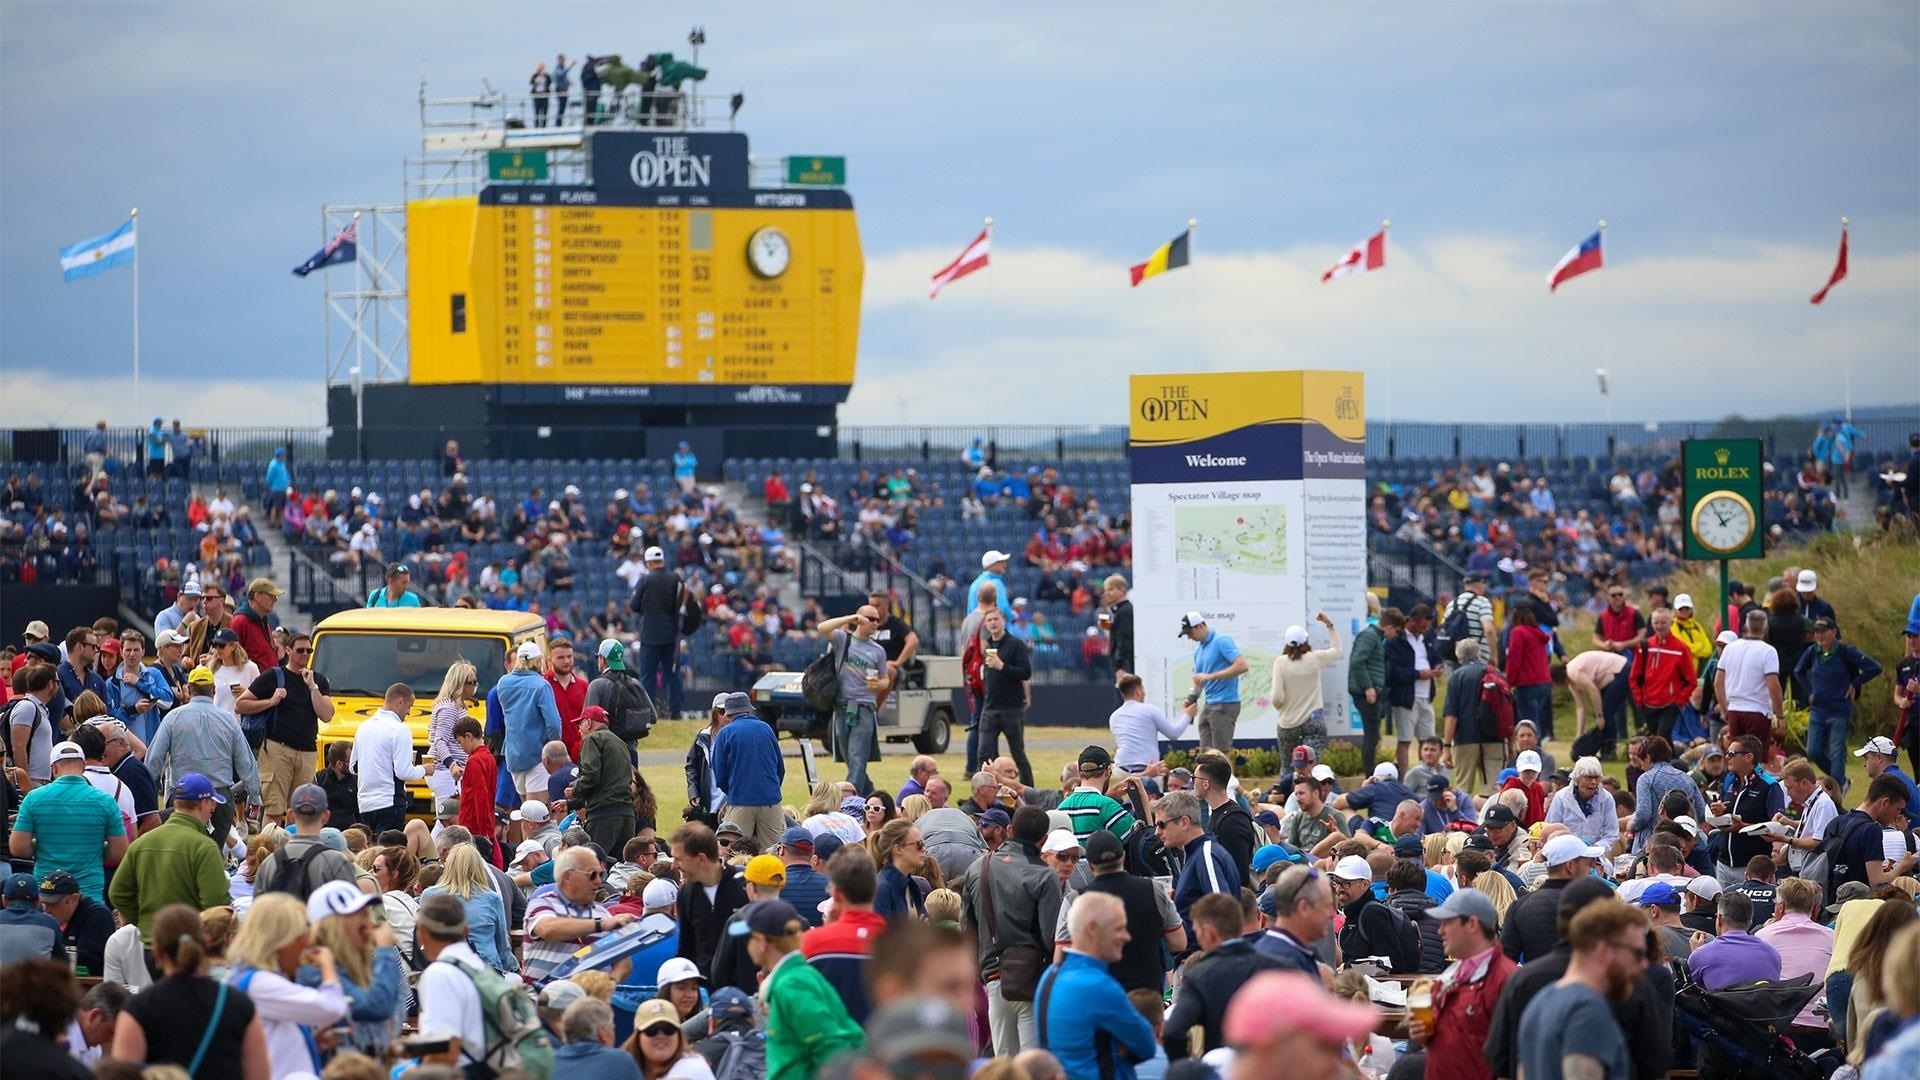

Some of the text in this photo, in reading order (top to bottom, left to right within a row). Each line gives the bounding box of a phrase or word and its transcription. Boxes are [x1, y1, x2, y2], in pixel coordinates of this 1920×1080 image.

[652, 136, 689, 157] THE
[630, 150, 713, 188] OPEN
[560, 191, 597, 204] PLAYER
[561, 209, 595, 220] LOWRY
[561, 239, 621, 250] FLEETWOOD
[562, 253, 618, 264] WESTWOOD
[562, 267, 592, 278] SMITH
[563, 296, 588, 307] ROSE
[563, 326, 603, 336] GLOVER
[1160, 386, 1189, 399] THE
[1141, 397, 1209, 422] OPEN
[1335, 396, 1359, 420] OPEN
[1185, 453, 1247, 467] Welcome
[1695, 467, 1750, 479] ROLEX
[1168, 491, 1261, 503] Spectator Village map
[1216, 613, 1236, 621] map
